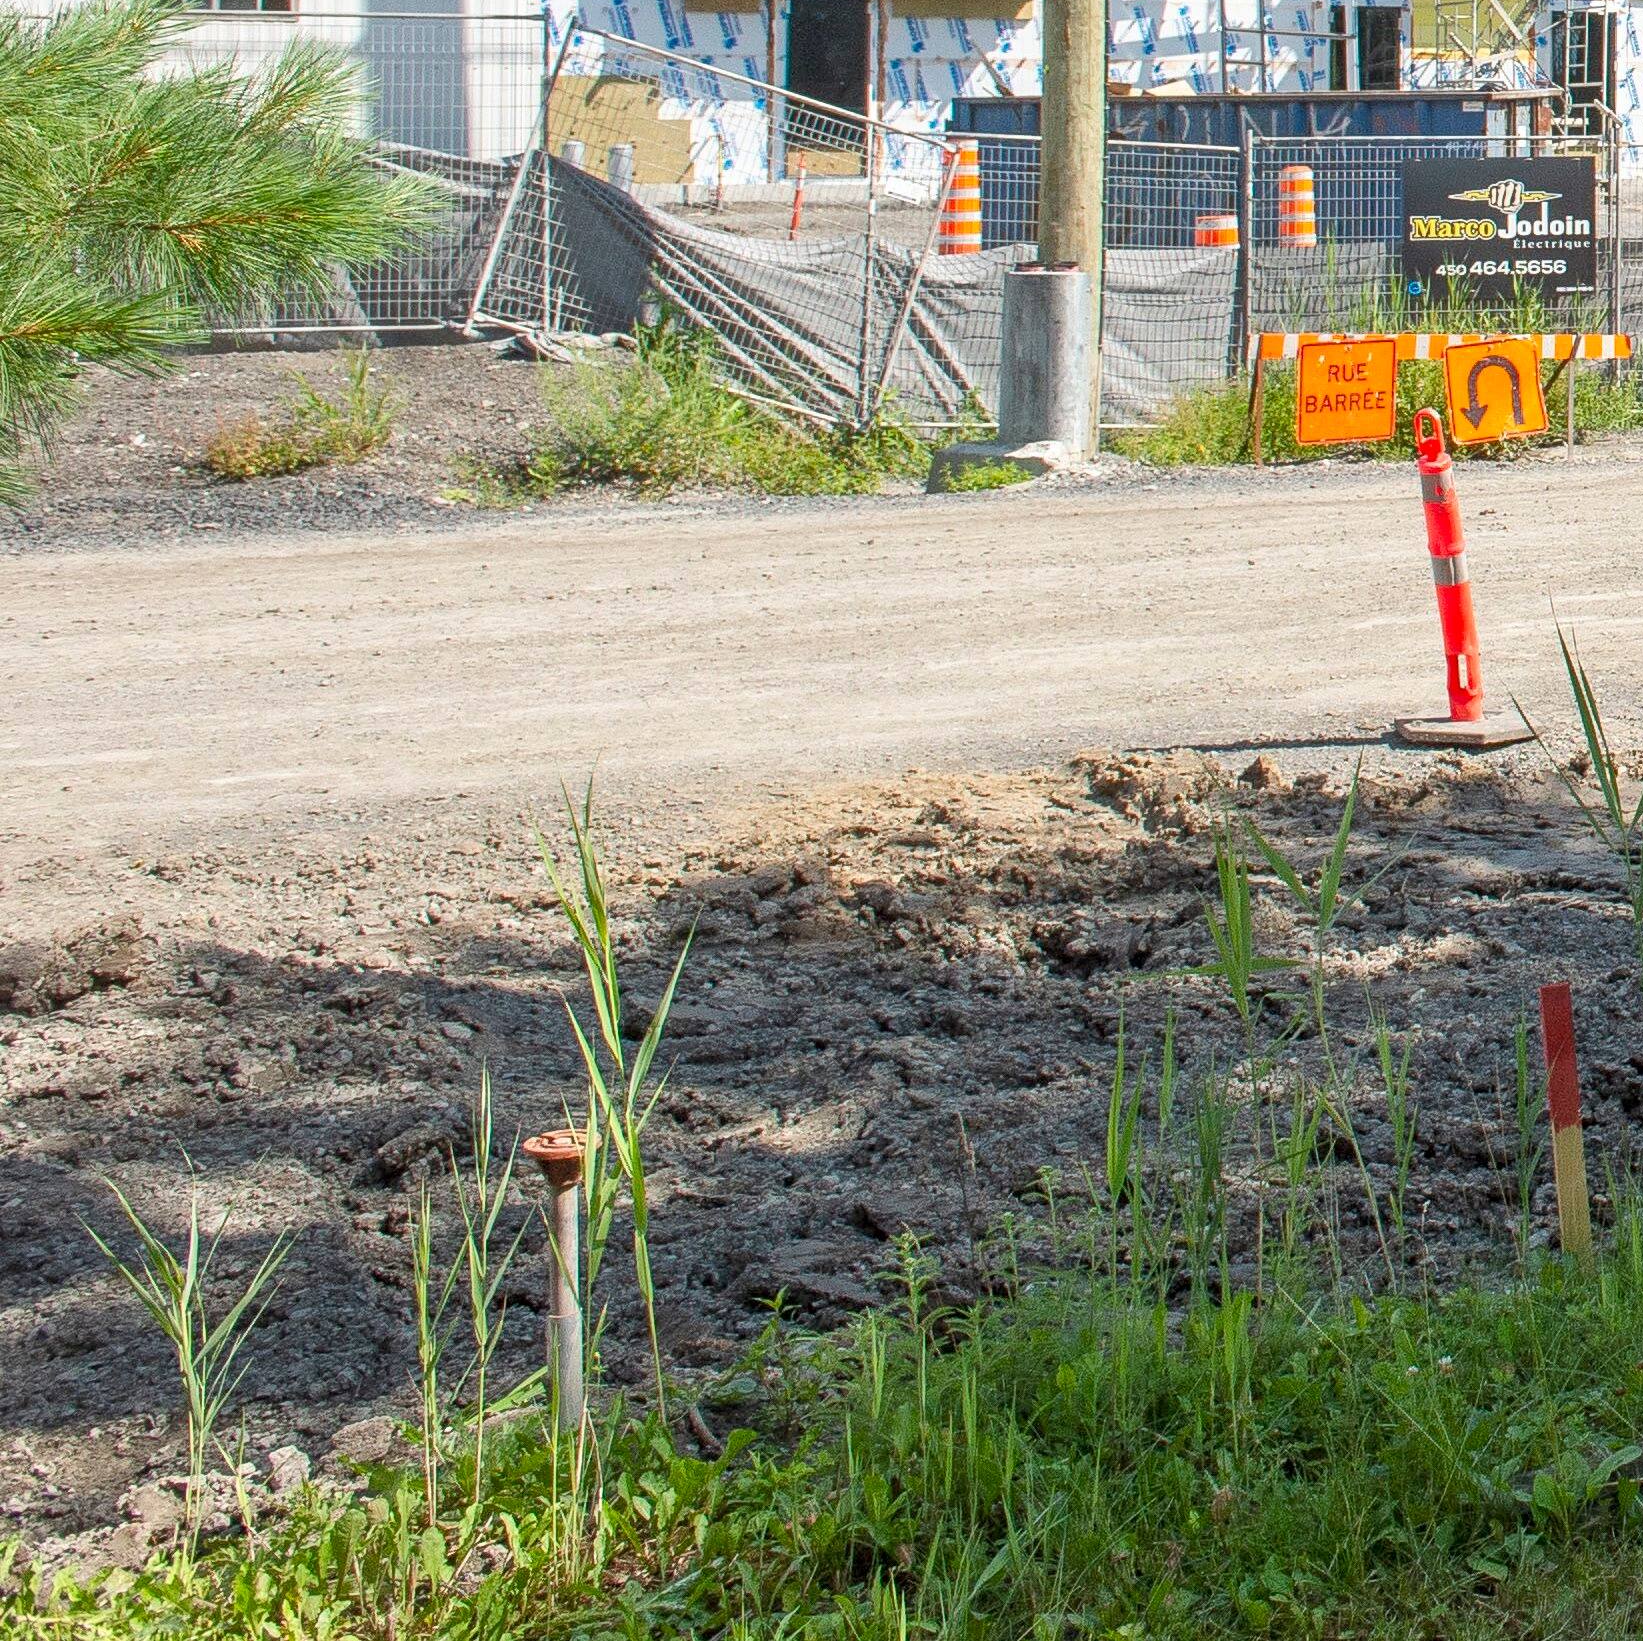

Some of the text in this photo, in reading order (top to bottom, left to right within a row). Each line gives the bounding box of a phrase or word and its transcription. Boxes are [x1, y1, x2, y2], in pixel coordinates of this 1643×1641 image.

[1411, 202, 1591, 241] Marco Jodoin
[1513, 238, 1591, 250] Électrique
[1435, 260, 1567, 276] 450 464.5656
[1328, 363, 1367, 382] RUE
[1305, 388, 1386, 413] BARRÉE
